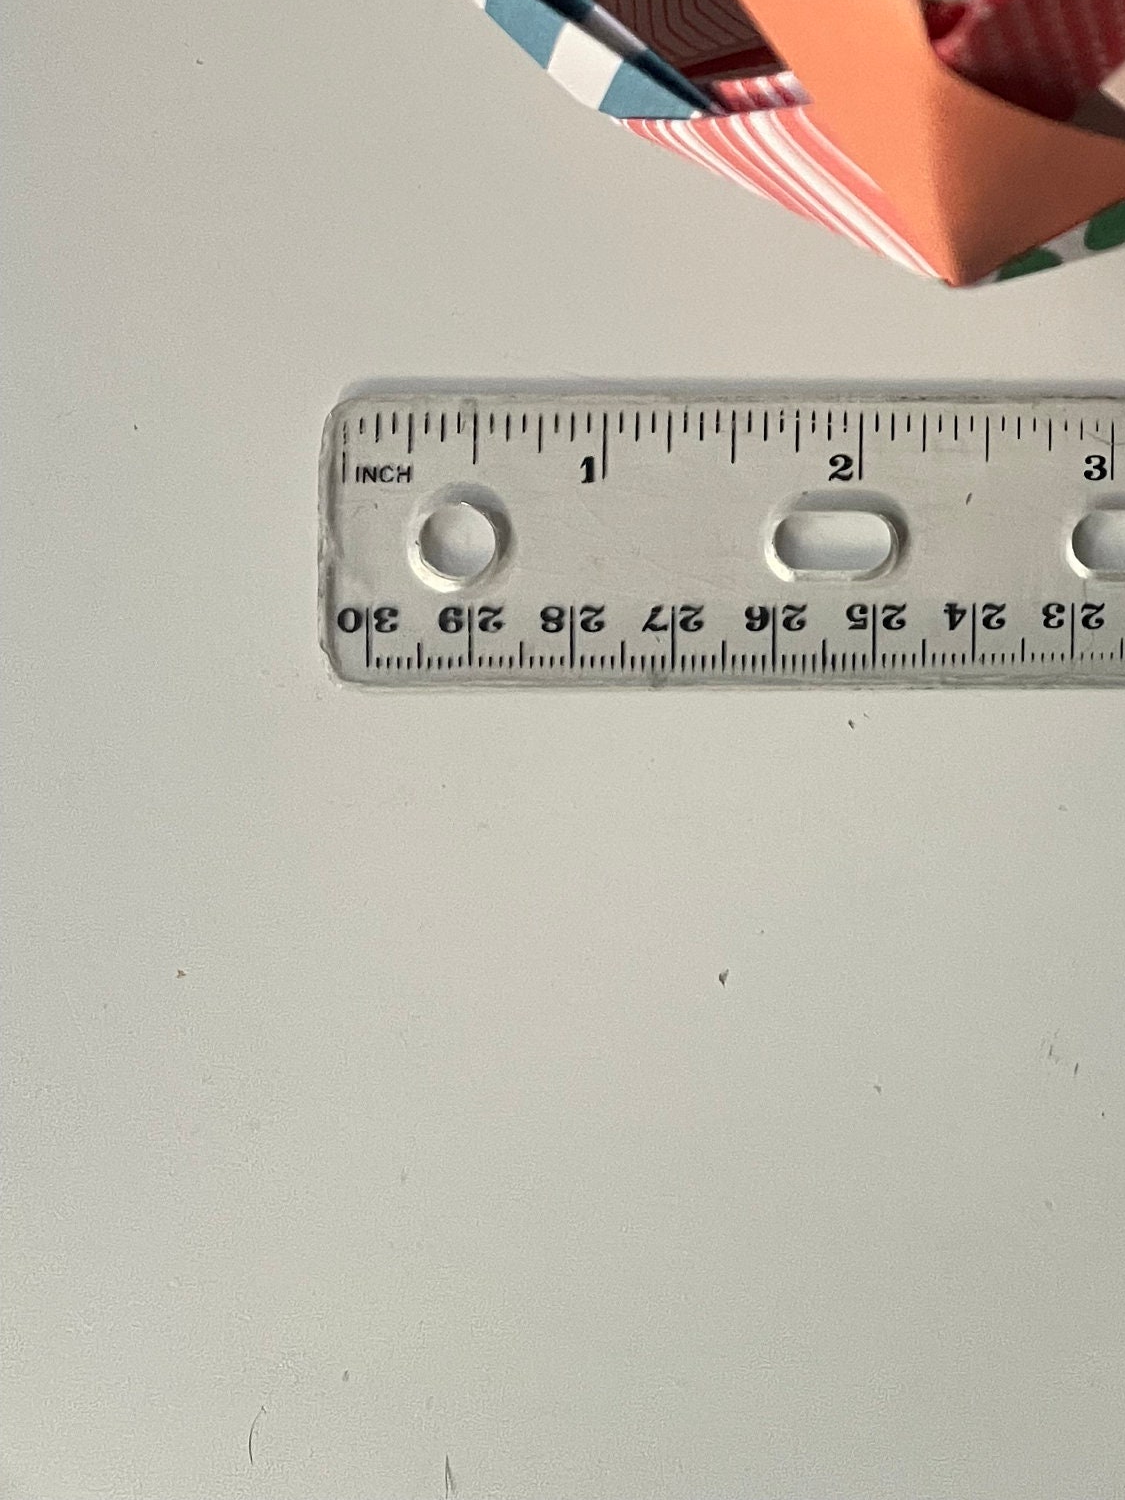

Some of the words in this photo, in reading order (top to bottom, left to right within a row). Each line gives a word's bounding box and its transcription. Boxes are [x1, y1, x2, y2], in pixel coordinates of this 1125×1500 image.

[355, 465, 411, 484] INCH
[579, 456, 595, 484] 1
[829, 454, 853, 481] 2
[1083, 455, 1107, 481] 3
[337, 606, 399, 633] 30
[438, 606, 505, 633] 29
[540, 605, 605, 633] 28
[642, 605, 704, 632] 27
[744, 604, 808, 631] 26
[846, 603, 907, 631] 25
[944, 603, 1006, 631] 24
[1042, 603, 1105, 630] 23
